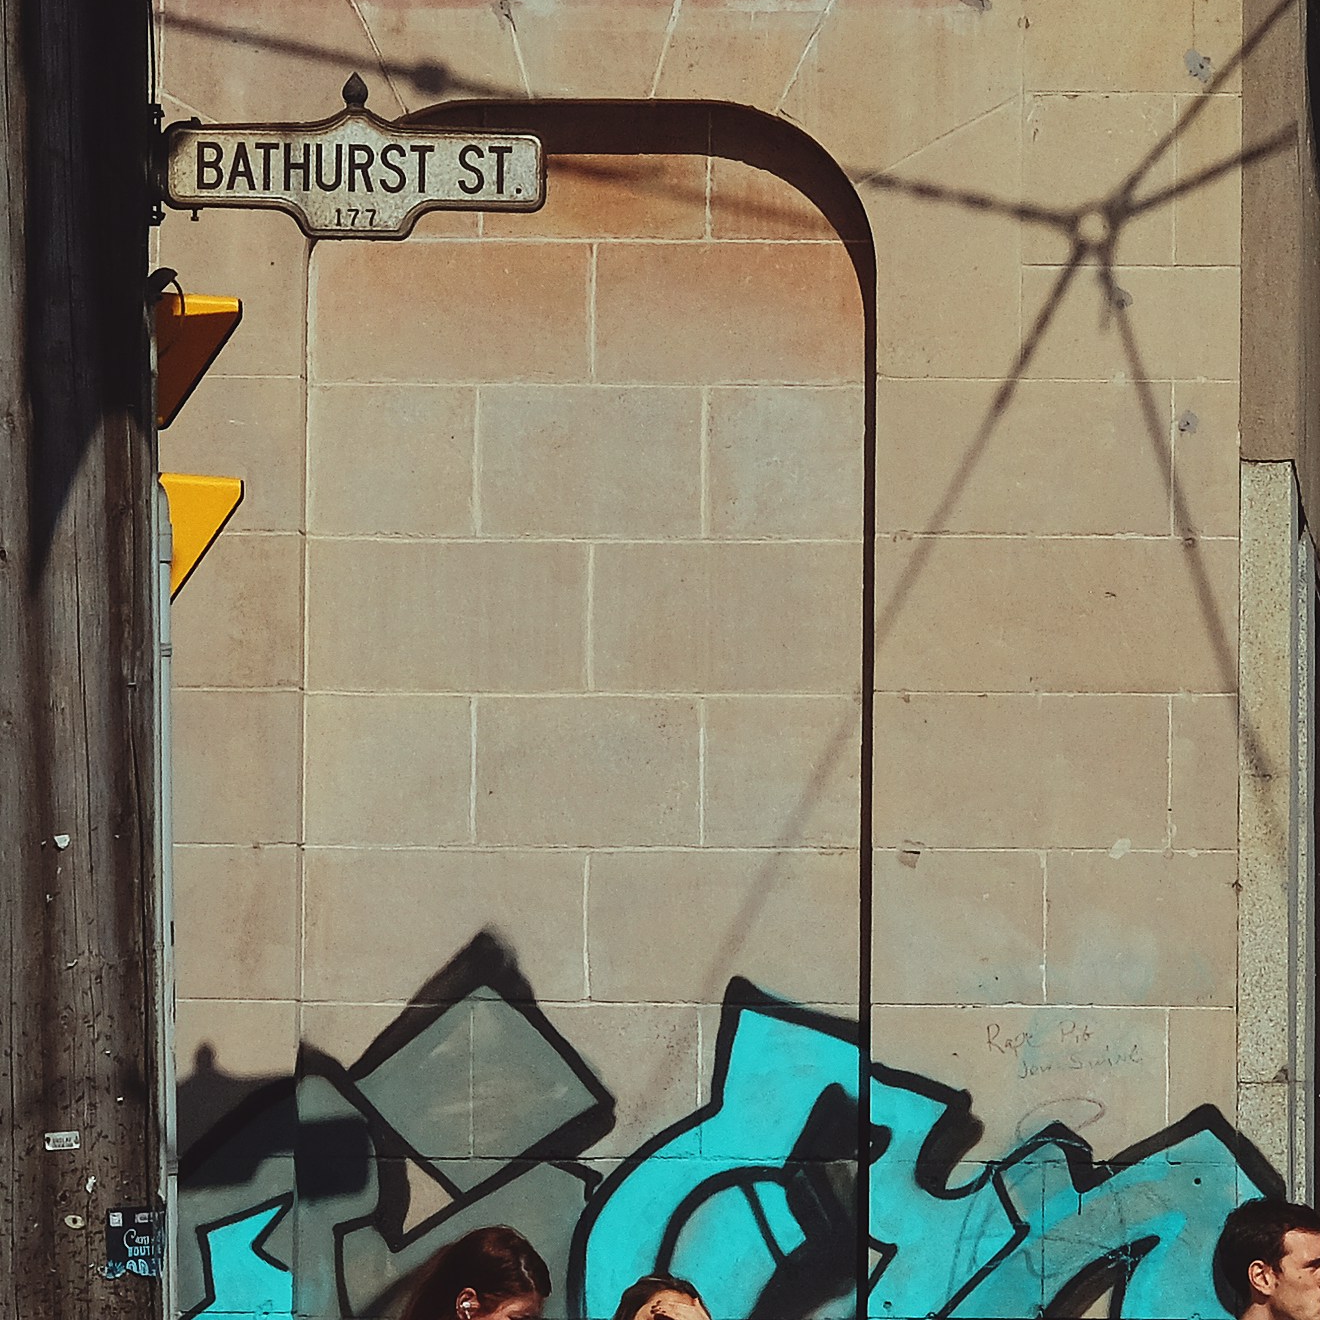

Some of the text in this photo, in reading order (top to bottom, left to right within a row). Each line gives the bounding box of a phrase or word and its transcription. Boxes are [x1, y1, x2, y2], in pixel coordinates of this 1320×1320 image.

[195, 140, 525, 196] BATHURST ST.
[334, 208, 377, 227] 177
